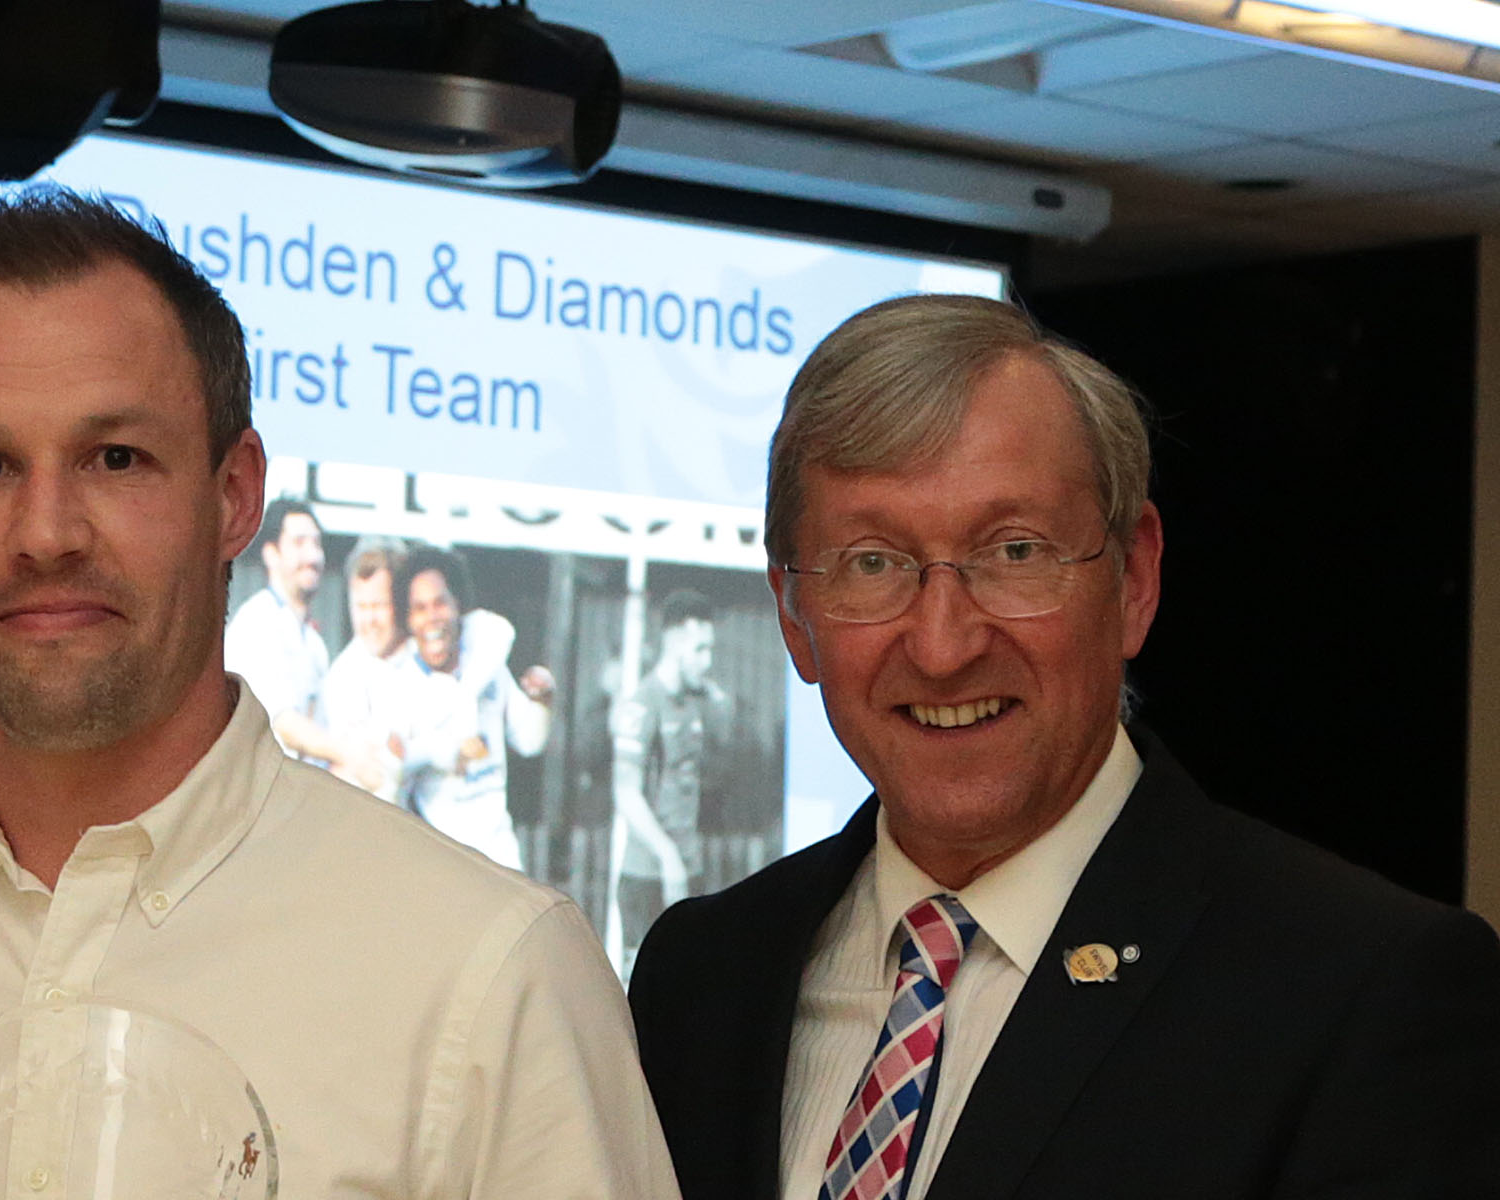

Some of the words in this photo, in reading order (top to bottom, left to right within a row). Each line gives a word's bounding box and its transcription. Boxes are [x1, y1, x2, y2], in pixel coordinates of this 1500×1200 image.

[425, 243, 466, 311] &
[495, 250, 794, 355] Diamonds
[245, 325, 348, 408] irst
[371, 343, 541, 431] Team
